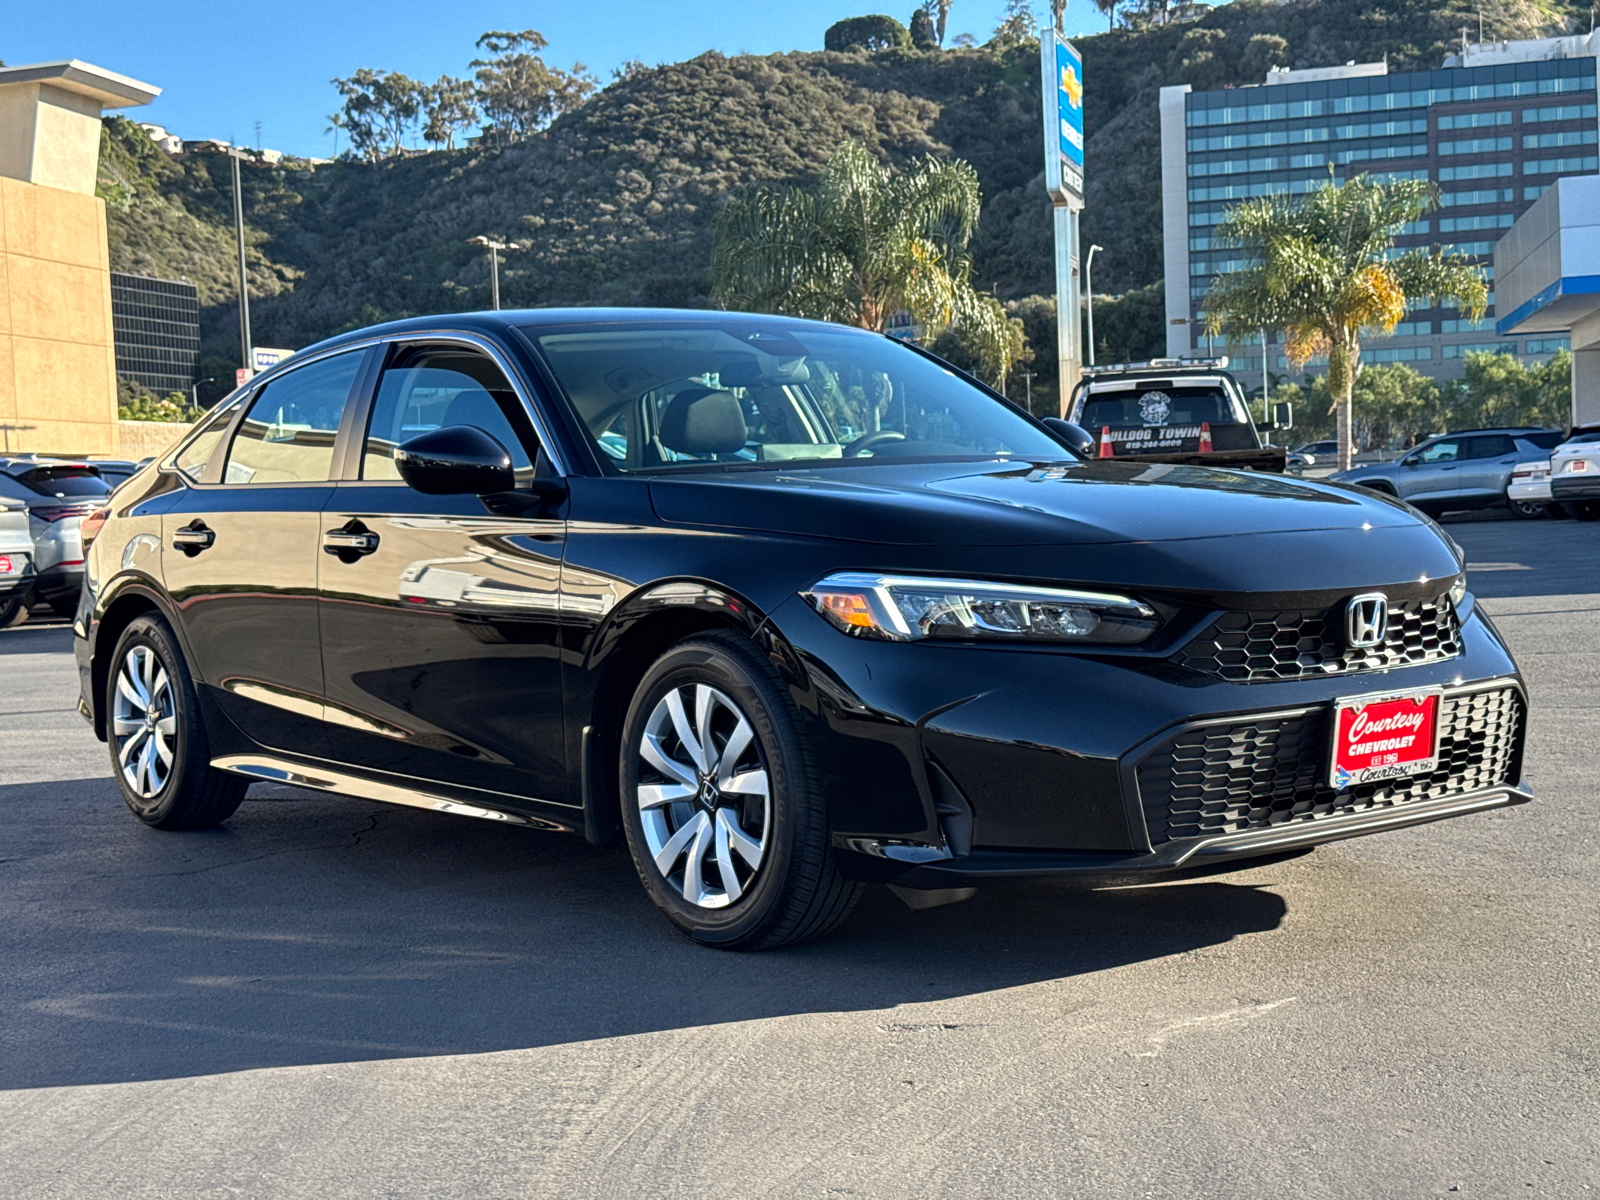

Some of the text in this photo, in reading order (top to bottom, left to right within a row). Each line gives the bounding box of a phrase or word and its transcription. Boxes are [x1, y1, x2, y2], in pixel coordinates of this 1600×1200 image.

[1109, 426, 1201, 442] ULLDOG TOWIN
[1348, 711, 1424, 743] Courtesy
[1348, 735, 1416, 756] CHEVROLET
[1383, 753, 1398, 764] 1961
